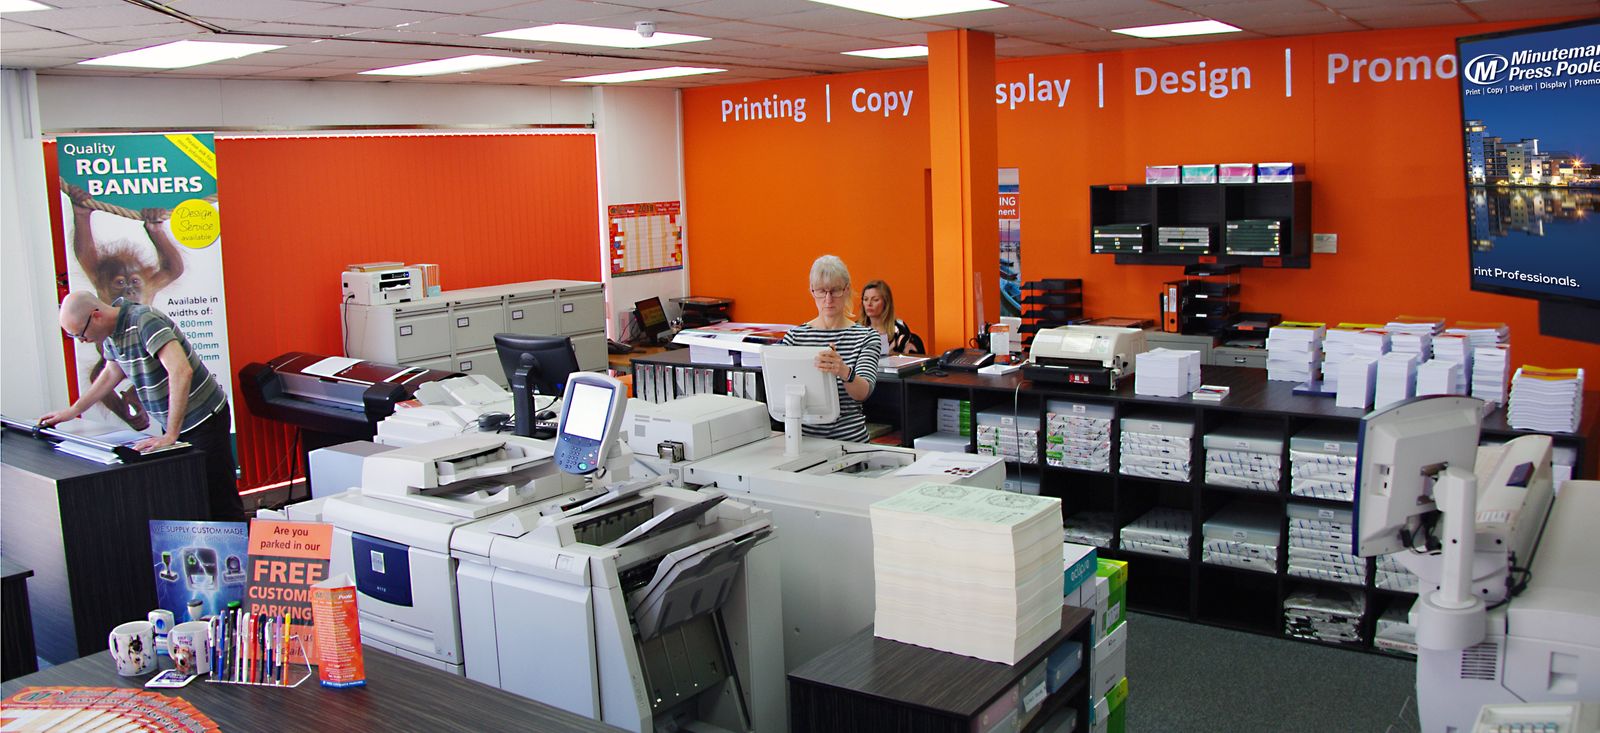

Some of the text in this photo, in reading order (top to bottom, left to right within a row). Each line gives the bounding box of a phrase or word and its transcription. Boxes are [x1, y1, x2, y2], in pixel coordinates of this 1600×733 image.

[1508, 58, 1600, 81] Press Poole
[721, 94, 807, 122] Printing
[851, 88, 914, 117] Copy
[1134, 61, 1252, 98] Design
[1465, 88, 1481, 96] Print
[1486, 86, 1504, 95] Copy
[1509, 84, 1534, 92] Design
[1540, 80, 1568, 90] Display
[63, 143, 116, 156] Quality
[76, 157, 168, 175] ROLLER
[87, 176, 204, 196] BANNERS
[176, 206, 212, 220] Design
[179, 219, 214, 232] Service
[1494, 267, 1580, 288] Professionals.
[167, 295, 218, 305] Available in
[168, 308, 198, 317] widths
[180, 319, 213, 328] 800mm
[185, 331, 213, 339] 50mm
[273, 526, 309, 538] Are you
[260, 540, 321, 551] parked in our
[254, 559, 323, 585] FREE
[251, 603, 312, 620] PARKING
